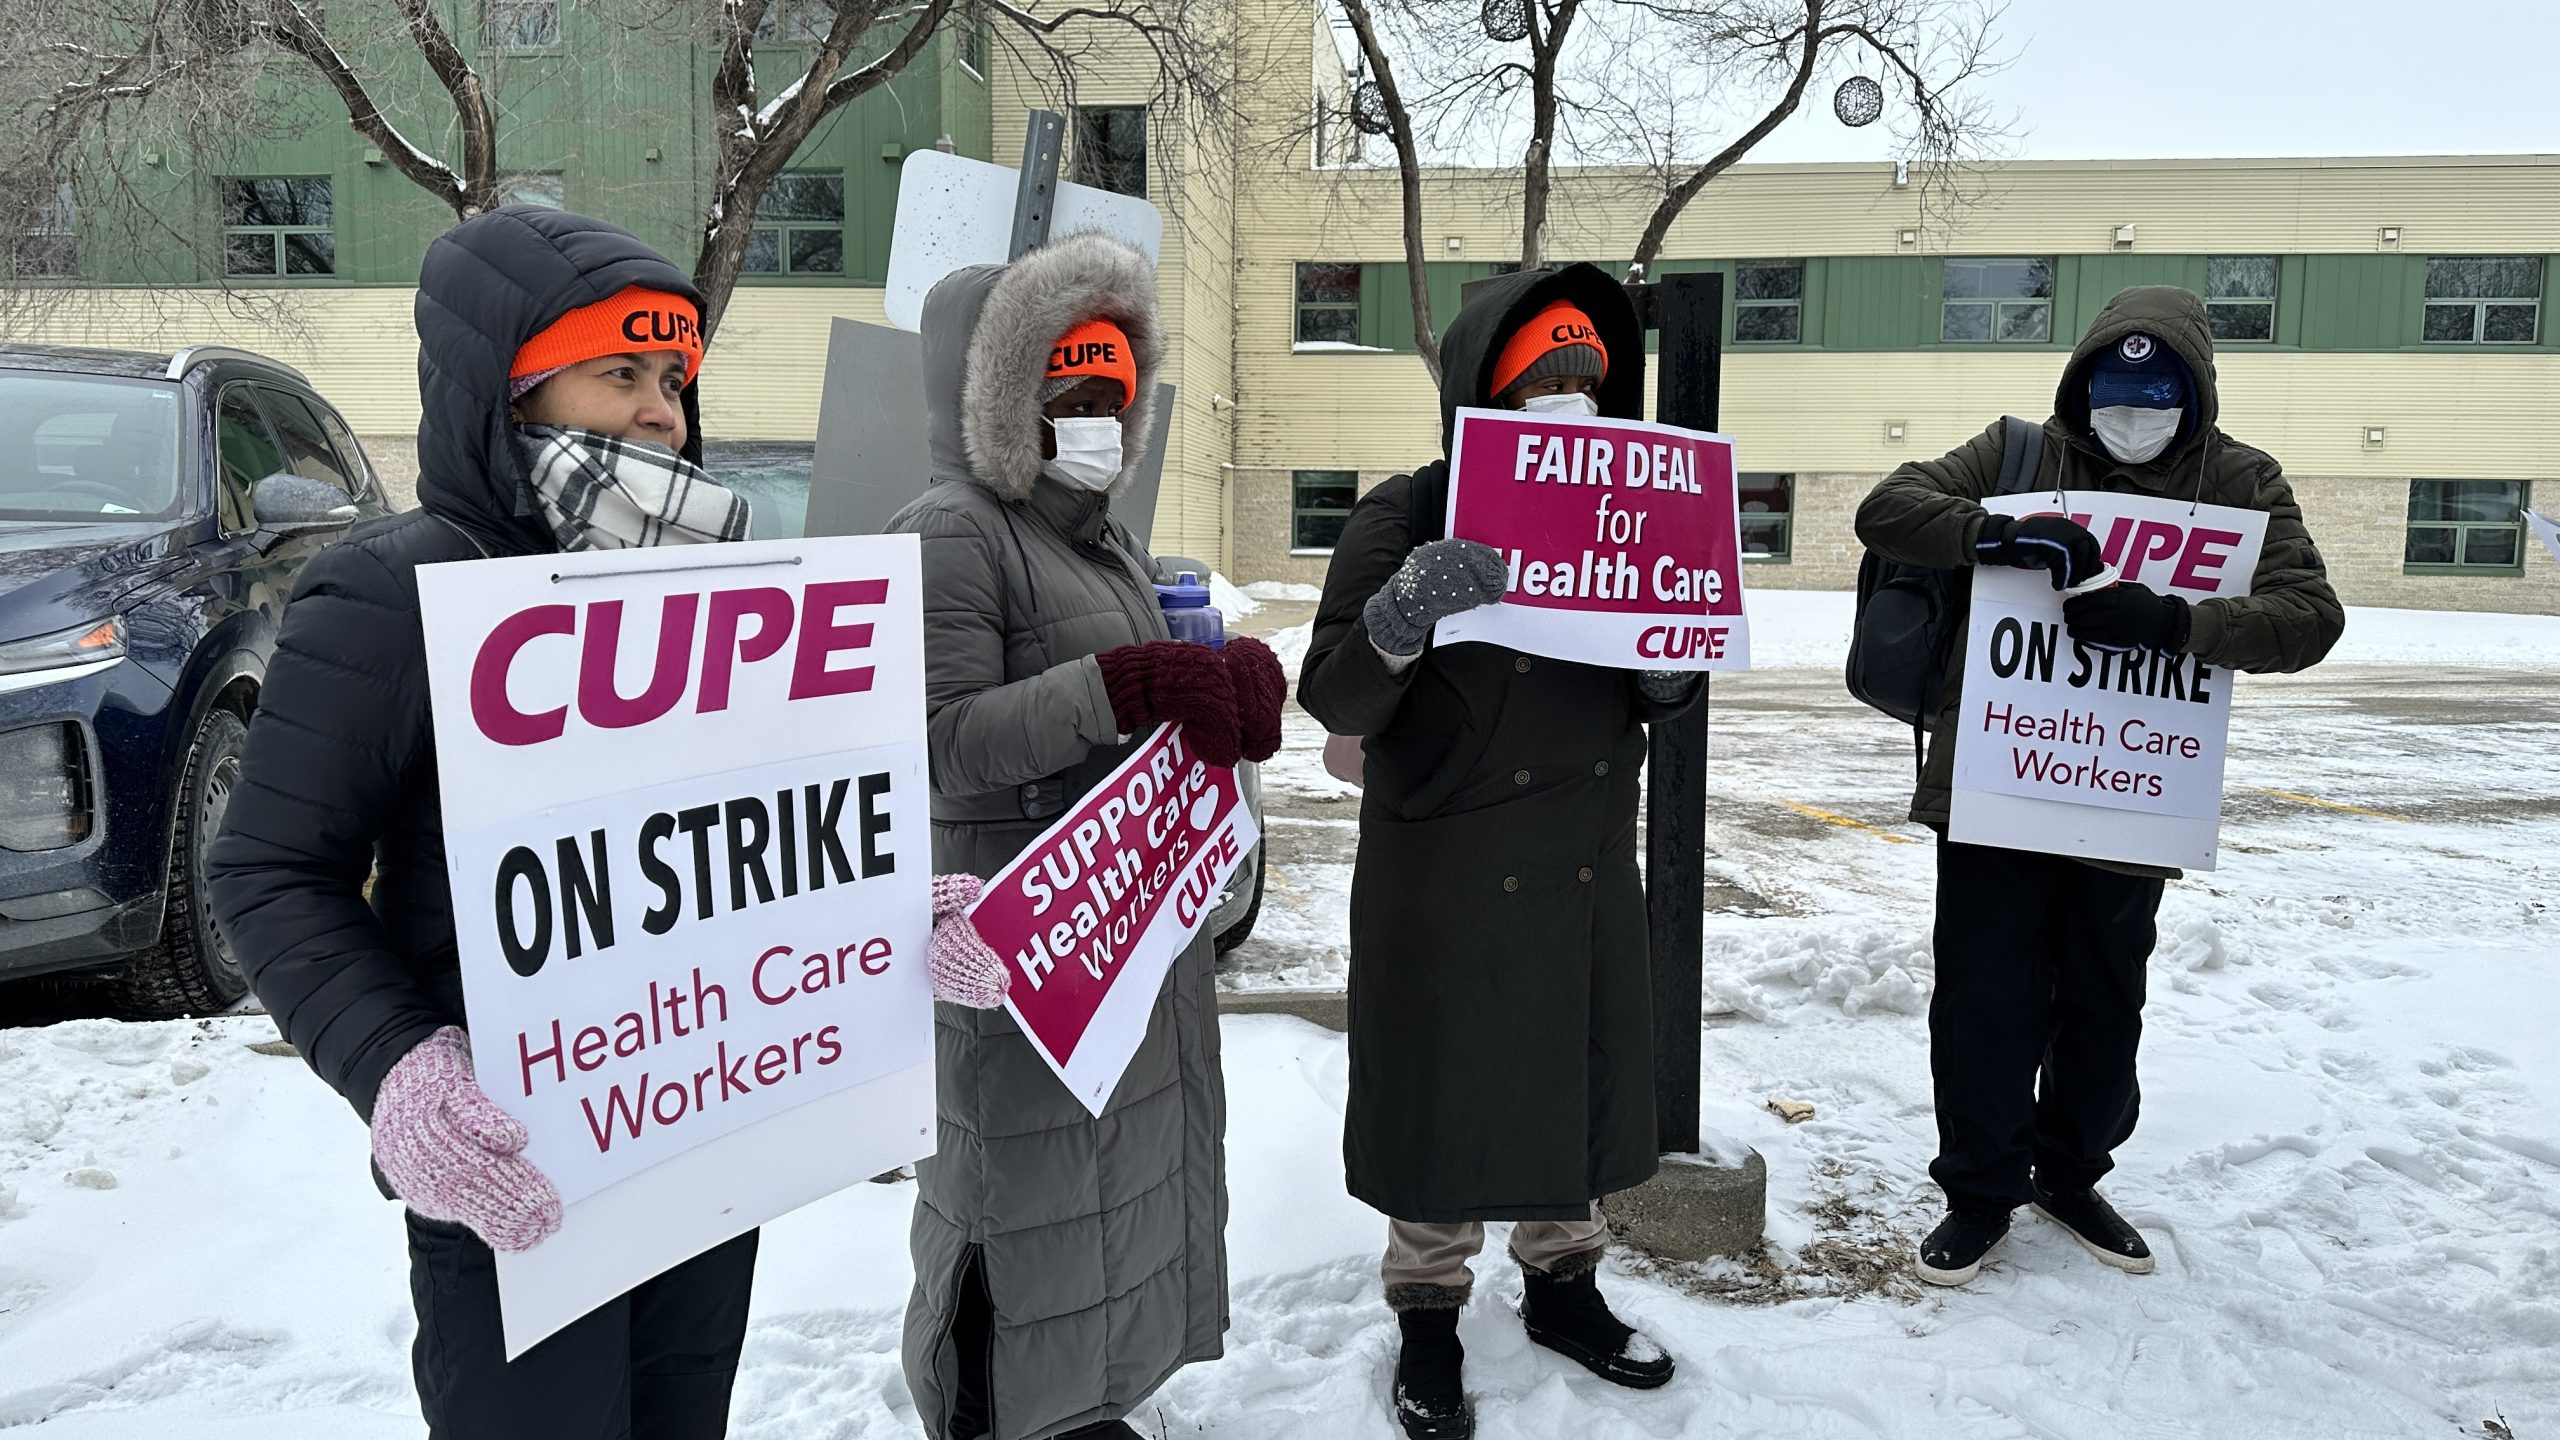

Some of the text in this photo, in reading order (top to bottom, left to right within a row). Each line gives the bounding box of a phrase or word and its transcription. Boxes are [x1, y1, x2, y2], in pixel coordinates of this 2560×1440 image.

[621, 310, 698, 349] CUPE
[1047, 342, 1117, 372] CUPE
[1515, 434, 1702, 494] FAIR DEAL
[1595, 493, 1648, 544] for
[1652, 555, 1723, 603] Care
[470, 578, 890, 747] CUPE
[1636, 625, 1730, 660] CUPE
[1989, 616, 2060, 683] ON
[1983, 701, 2201, 759] Health Care
[2012, 747, 2163, 797] Workers
[1021, 724, 1185, 917] SUPPORT
[495, 771, 896, 978] ON STRIKE
[1015, 760, 1207, 992] Health Care
[1079, 828, 1190, 982] Workers
[1175, 823, 1239, 929] CUPE
[518, 936, 894, 1098] Health Care
[580, 1024, 843, 1155] Workers
